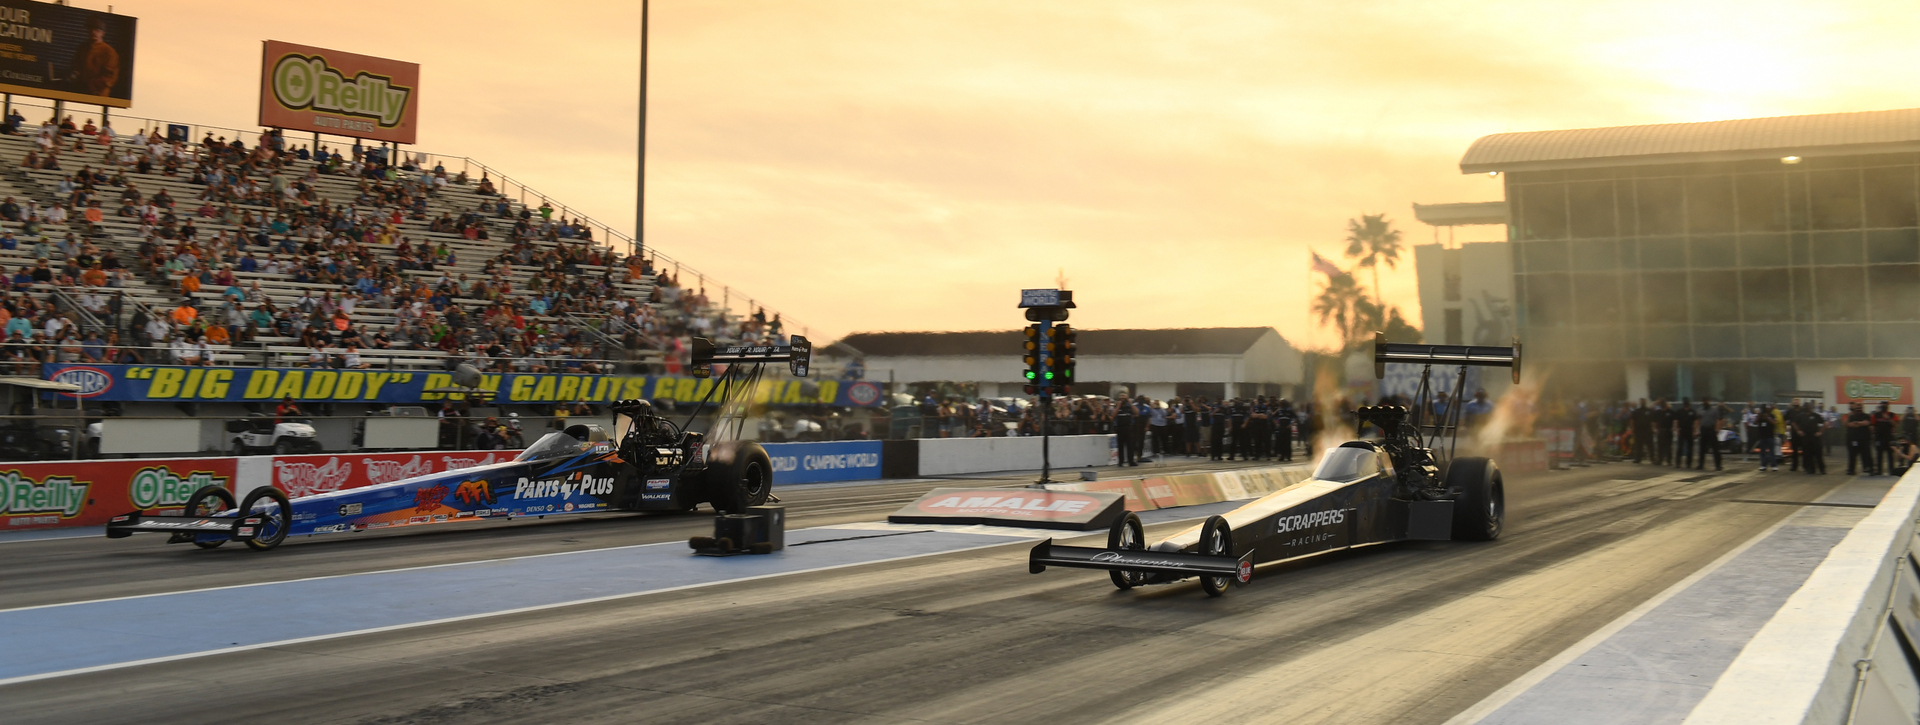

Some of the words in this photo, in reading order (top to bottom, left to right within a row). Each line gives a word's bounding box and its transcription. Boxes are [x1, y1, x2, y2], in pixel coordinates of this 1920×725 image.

[276, 58, 405, 125] O'Reilly
[314, 115, 341, 129] AUTO
[342, 119, 375, 133] PARTS
[1022, 296, 1058, 305] WORLD
[509, 375, 644, 402] GARLITS
[1846, 380, 1902, 400] O'Reilly
[803, 454, 846, 471] CAMPING
[846, 453, 879, 468] WORLD
[514, 477, 560, 500] PARTS
[579, 474, 614, 496] PLUS
[927, 496, 1092, 514] AMALIE
[956, 507, 1008, 515] MOTOR
[9, 518, 31, 526] AUTO
[1277, 508, 1345, 534] SCRAPPERS
[1291, 533, 1328, 547] RACING
